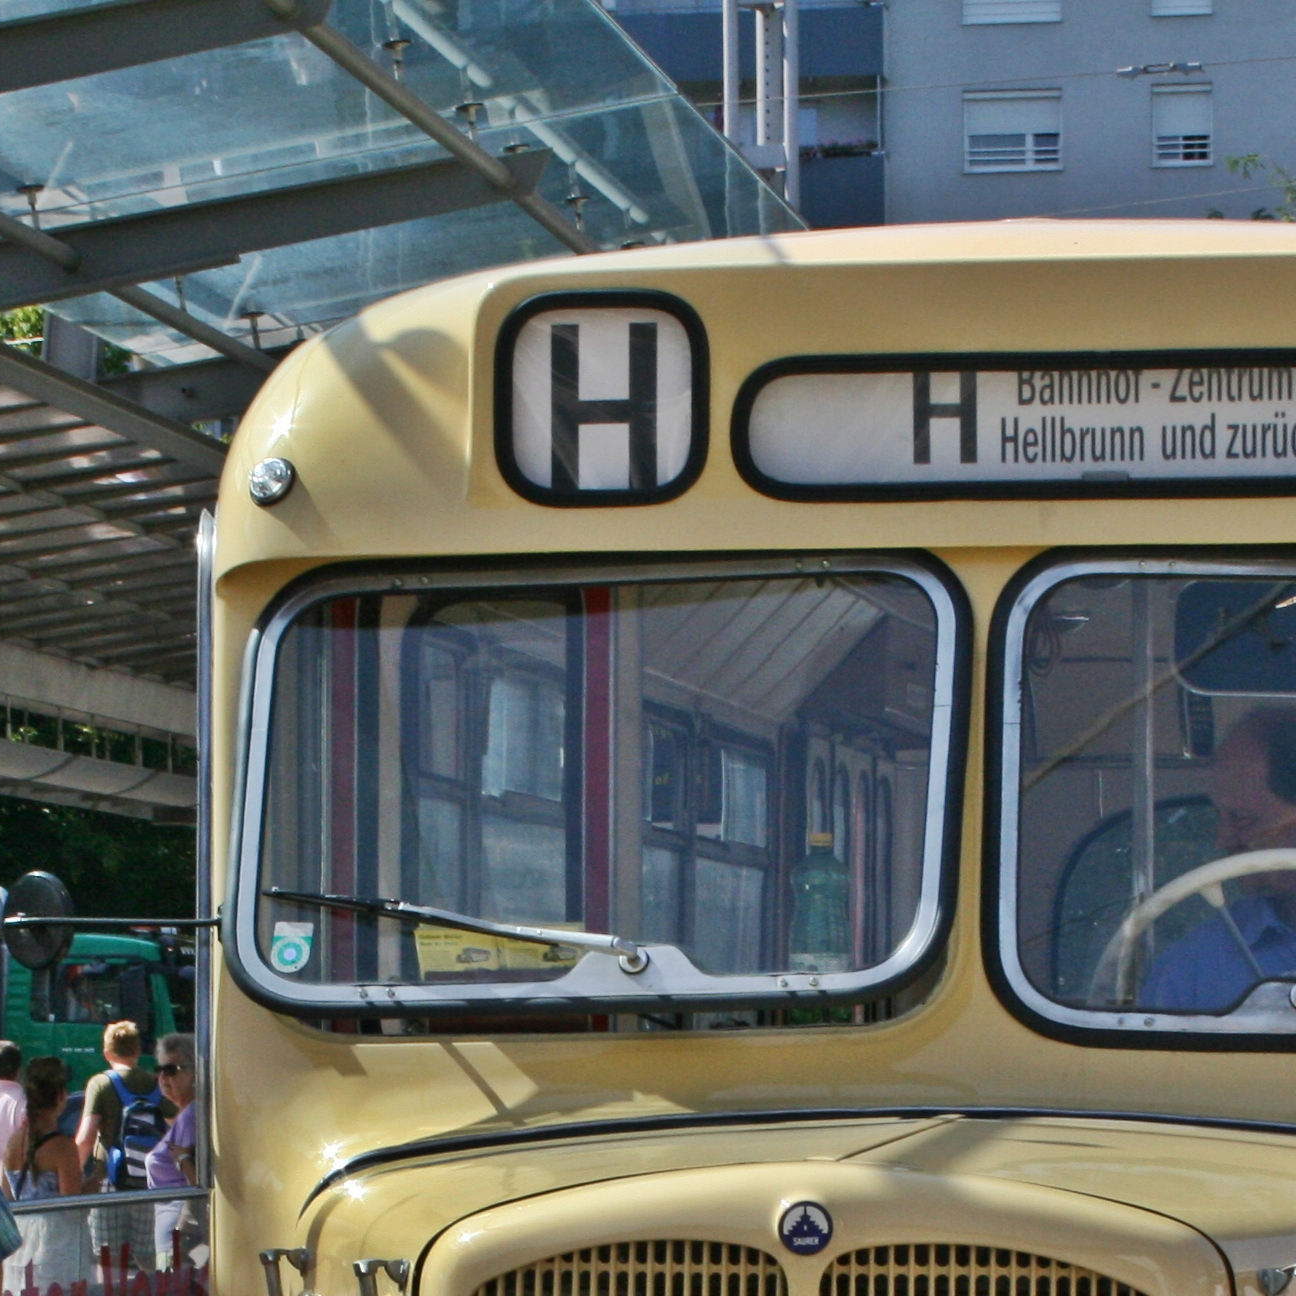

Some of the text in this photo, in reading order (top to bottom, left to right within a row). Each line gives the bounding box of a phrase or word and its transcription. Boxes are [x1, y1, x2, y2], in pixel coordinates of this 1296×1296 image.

[550, 322, 658, 491] H
[912, 371, 978, 464] H
[1017, 369, 1143, 406] Bahnhof
[1000, 415, 1145, 464] Hellbrunn
[1161, 412, 1217, 461] und
